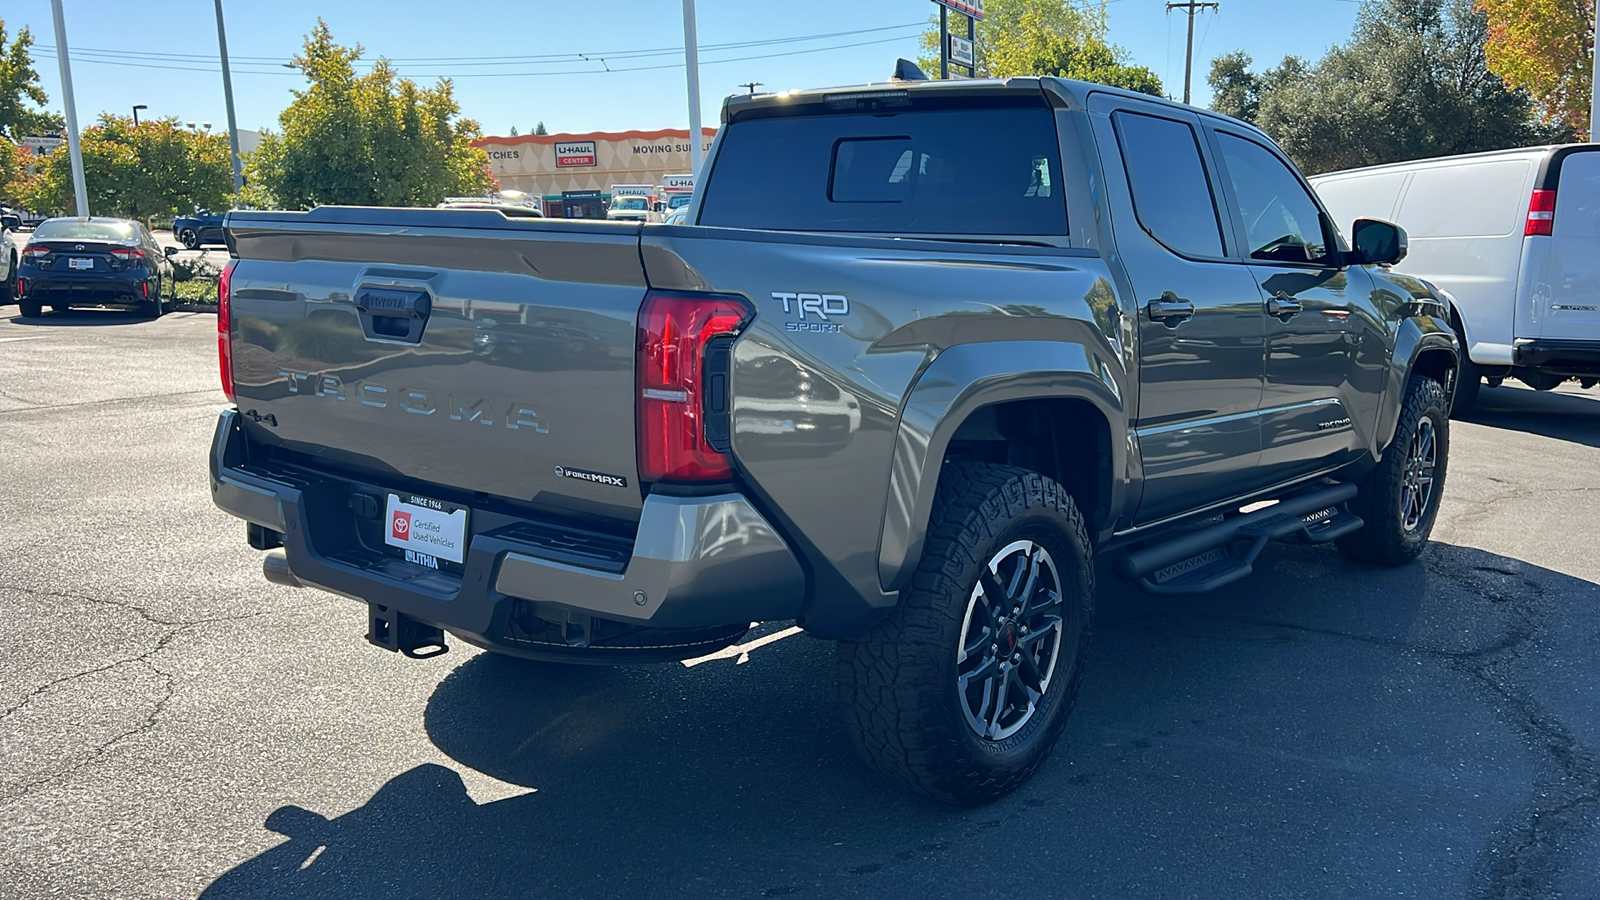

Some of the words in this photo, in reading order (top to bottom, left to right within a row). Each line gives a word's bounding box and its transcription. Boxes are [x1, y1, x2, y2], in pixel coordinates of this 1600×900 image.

[633, 144, 672, 154] MOVING
[371, 296, 405, 309] TOYOTA
[771, 291, 849, 321] TRD
[786, 322, 844, 333] SPORT
[277, 367, 549, 434] TACOMA
[410, 496, 427, 507] SINCE
[428, 499, 442, 510] 1946
[414, 519, 441, 533] Certified
[413, 531, 429, 543] Used
[429, 535, 455, 549] Vehicles
[412, 551, 439, 570] LITHIA
